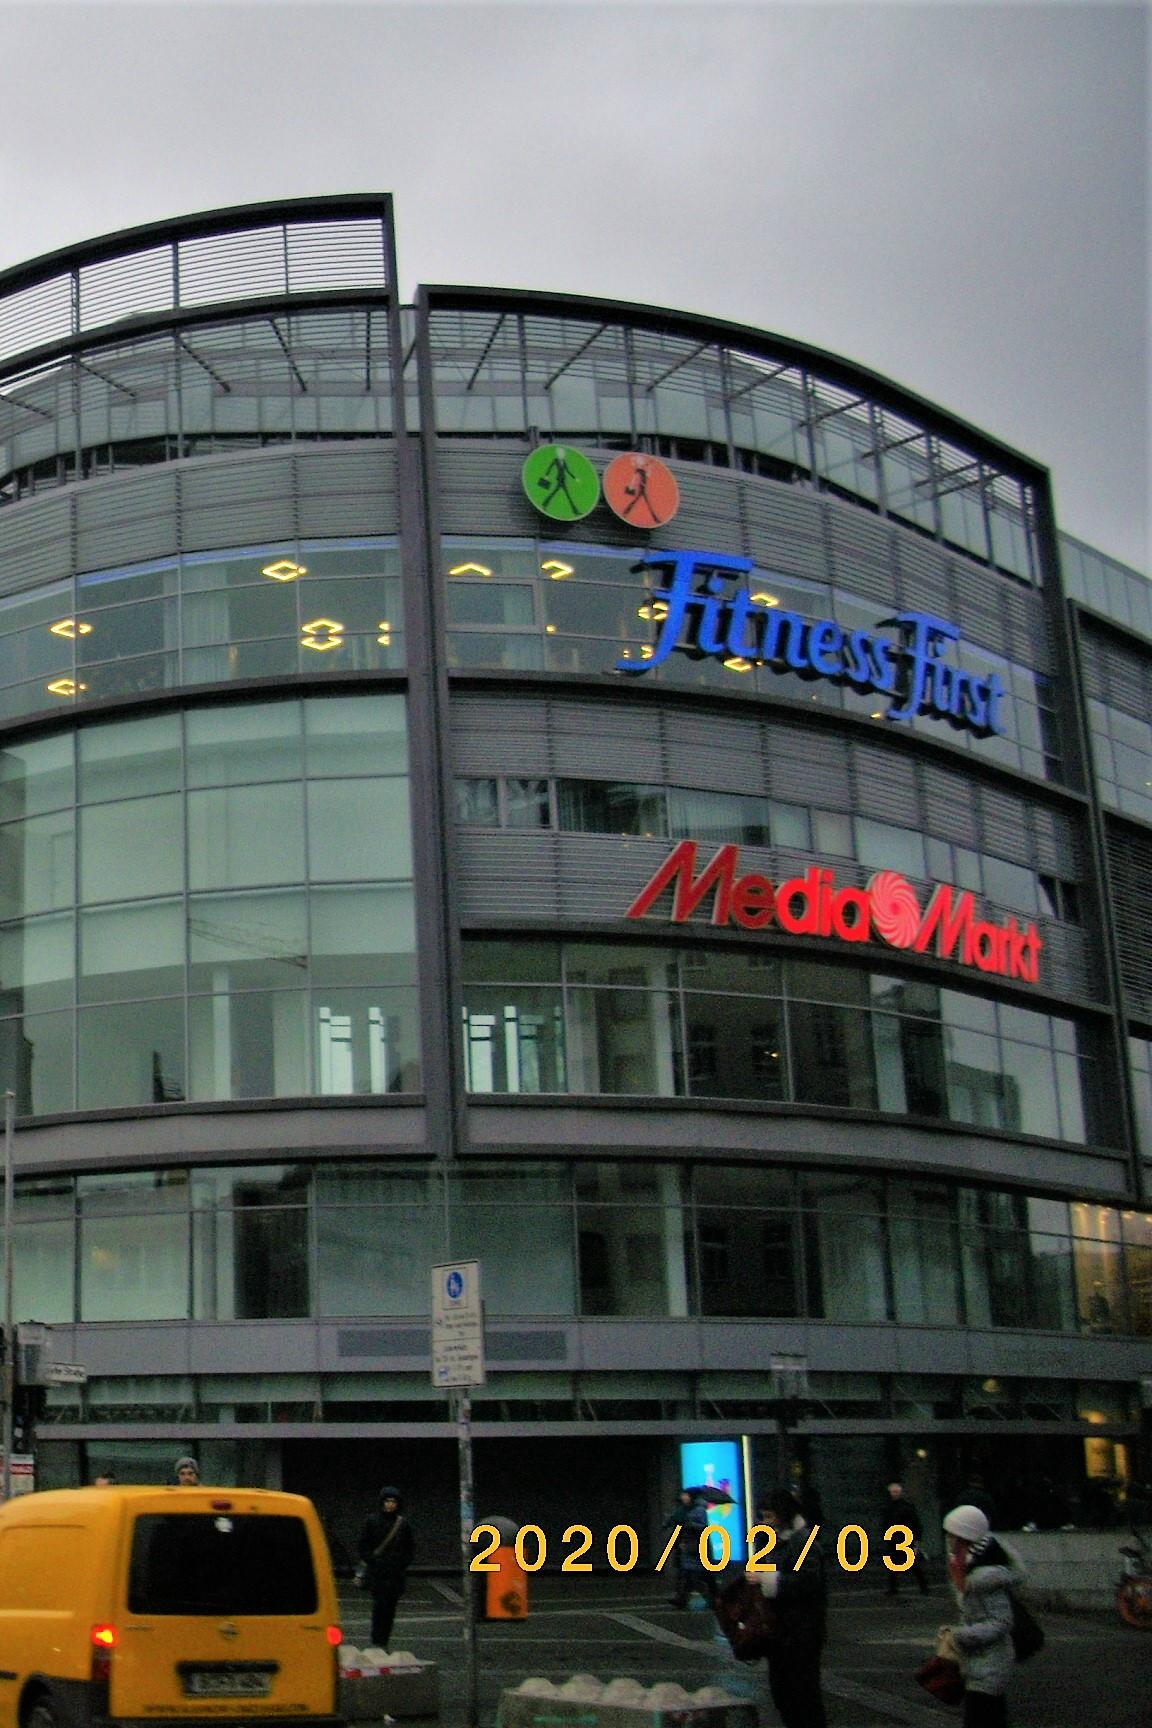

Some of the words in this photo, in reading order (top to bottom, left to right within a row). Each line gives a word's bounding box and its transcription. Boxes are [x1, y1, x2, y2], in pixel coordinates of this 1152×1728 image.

[616, 551, 895, 691] Fitness
[885, 612, 1007, 734] First
[624, 840, 871, 943] Media
[913, 884, 1042, 984] Markt
